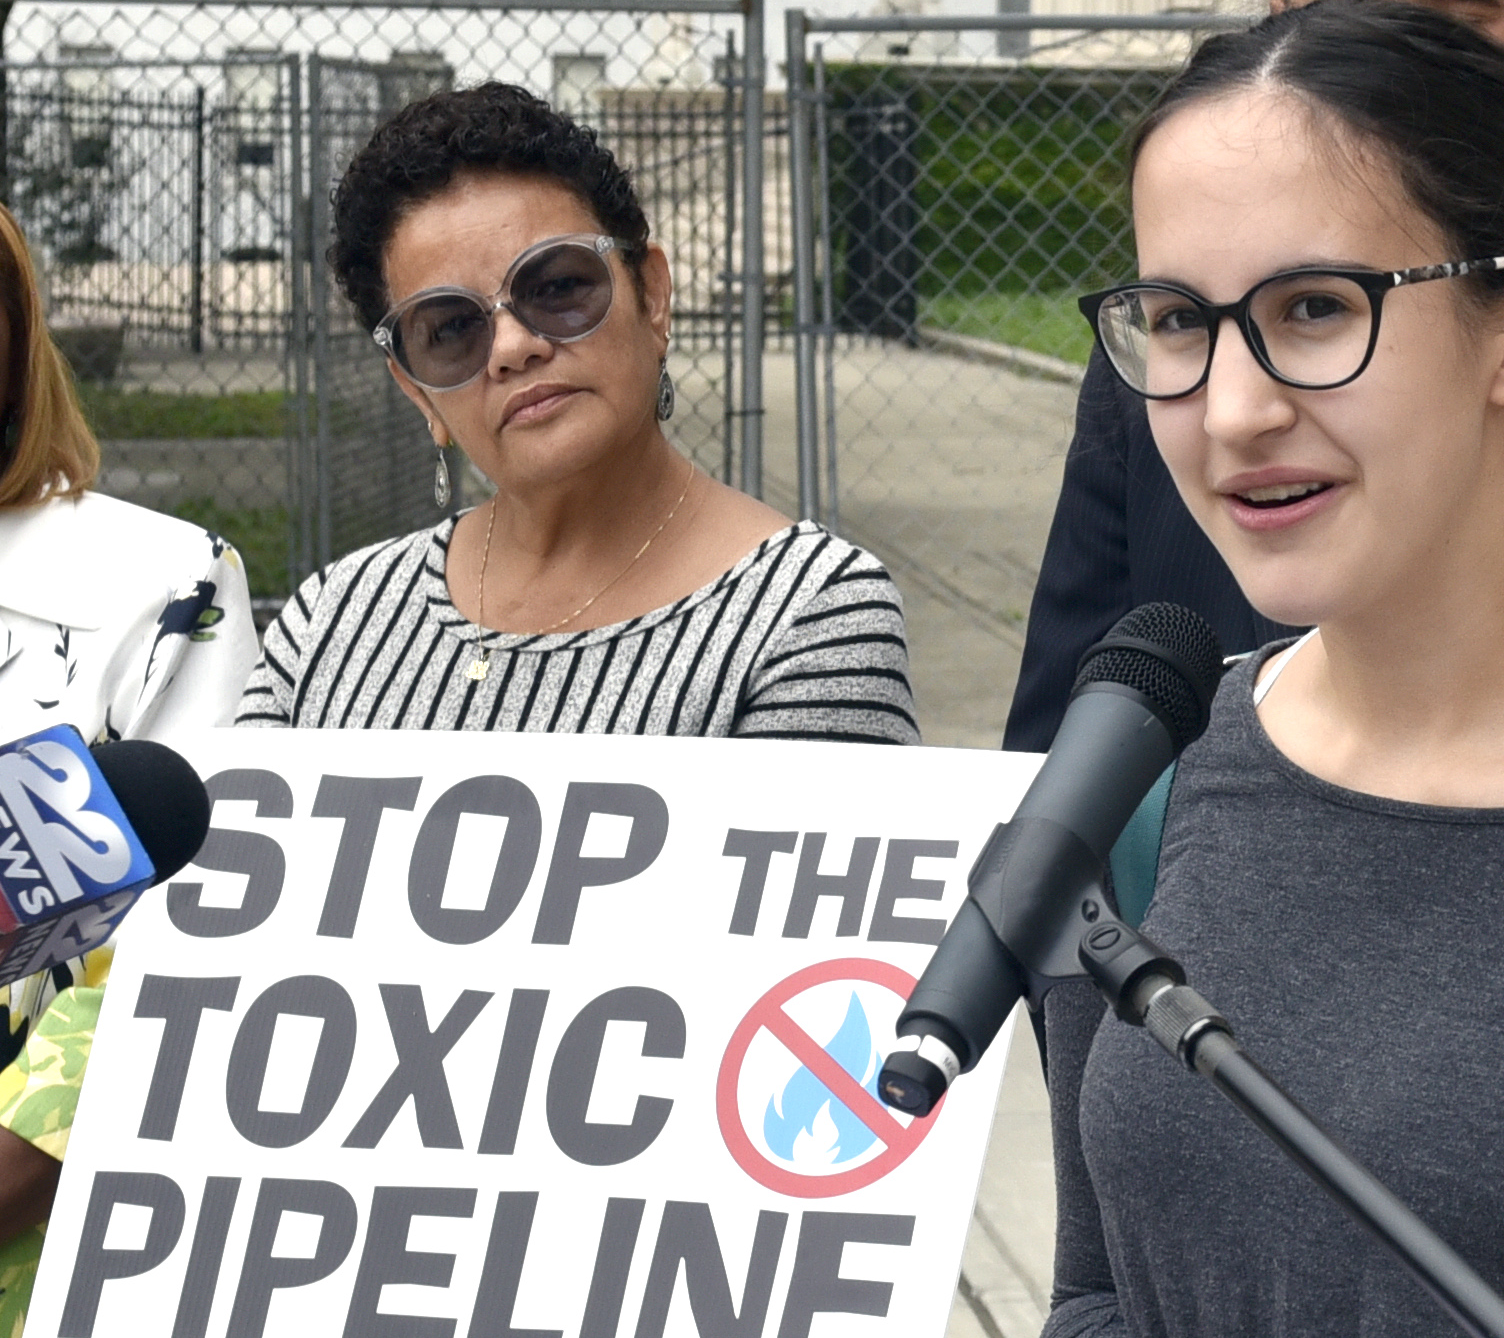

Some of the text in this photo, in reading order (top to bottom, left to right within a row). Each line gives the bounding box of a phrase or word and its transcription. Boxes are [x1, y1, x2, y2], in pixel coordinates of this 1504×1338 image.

[166, 768, 960, 946] STOP THE
[132, 973, 688, 1167] TOXIC
